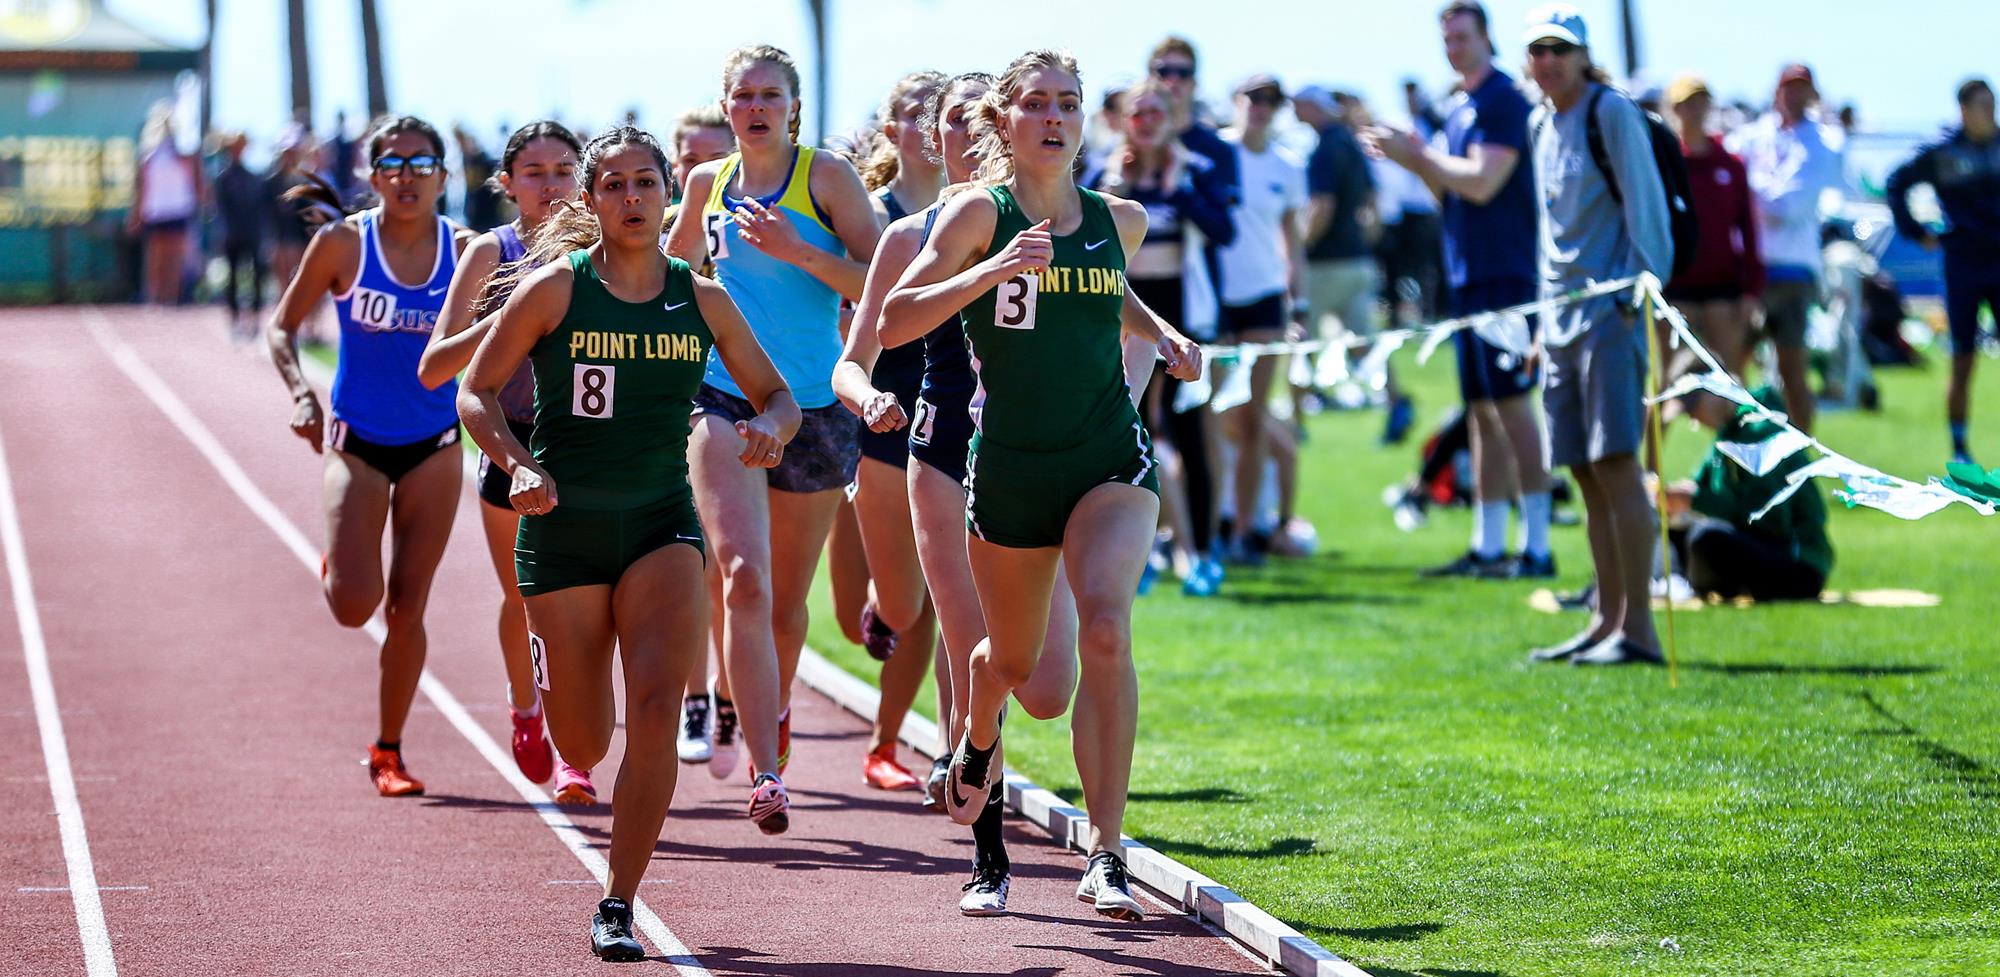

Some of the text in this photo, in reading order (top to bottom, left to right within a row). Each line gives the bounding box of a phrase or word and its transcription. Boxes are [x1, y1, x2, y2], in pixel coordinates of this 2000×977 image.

[708, 215, 720, 257] 5
[1002, 276, 1029, 326] 3
[1022, 266, 1124, 297] INT LOMA
[361, 291, 387, 323] 10
[569, 331, 702, 362] POINT LOMA
[581, 368, 607, 416] 8
[531, 637, 543, 685] 8
